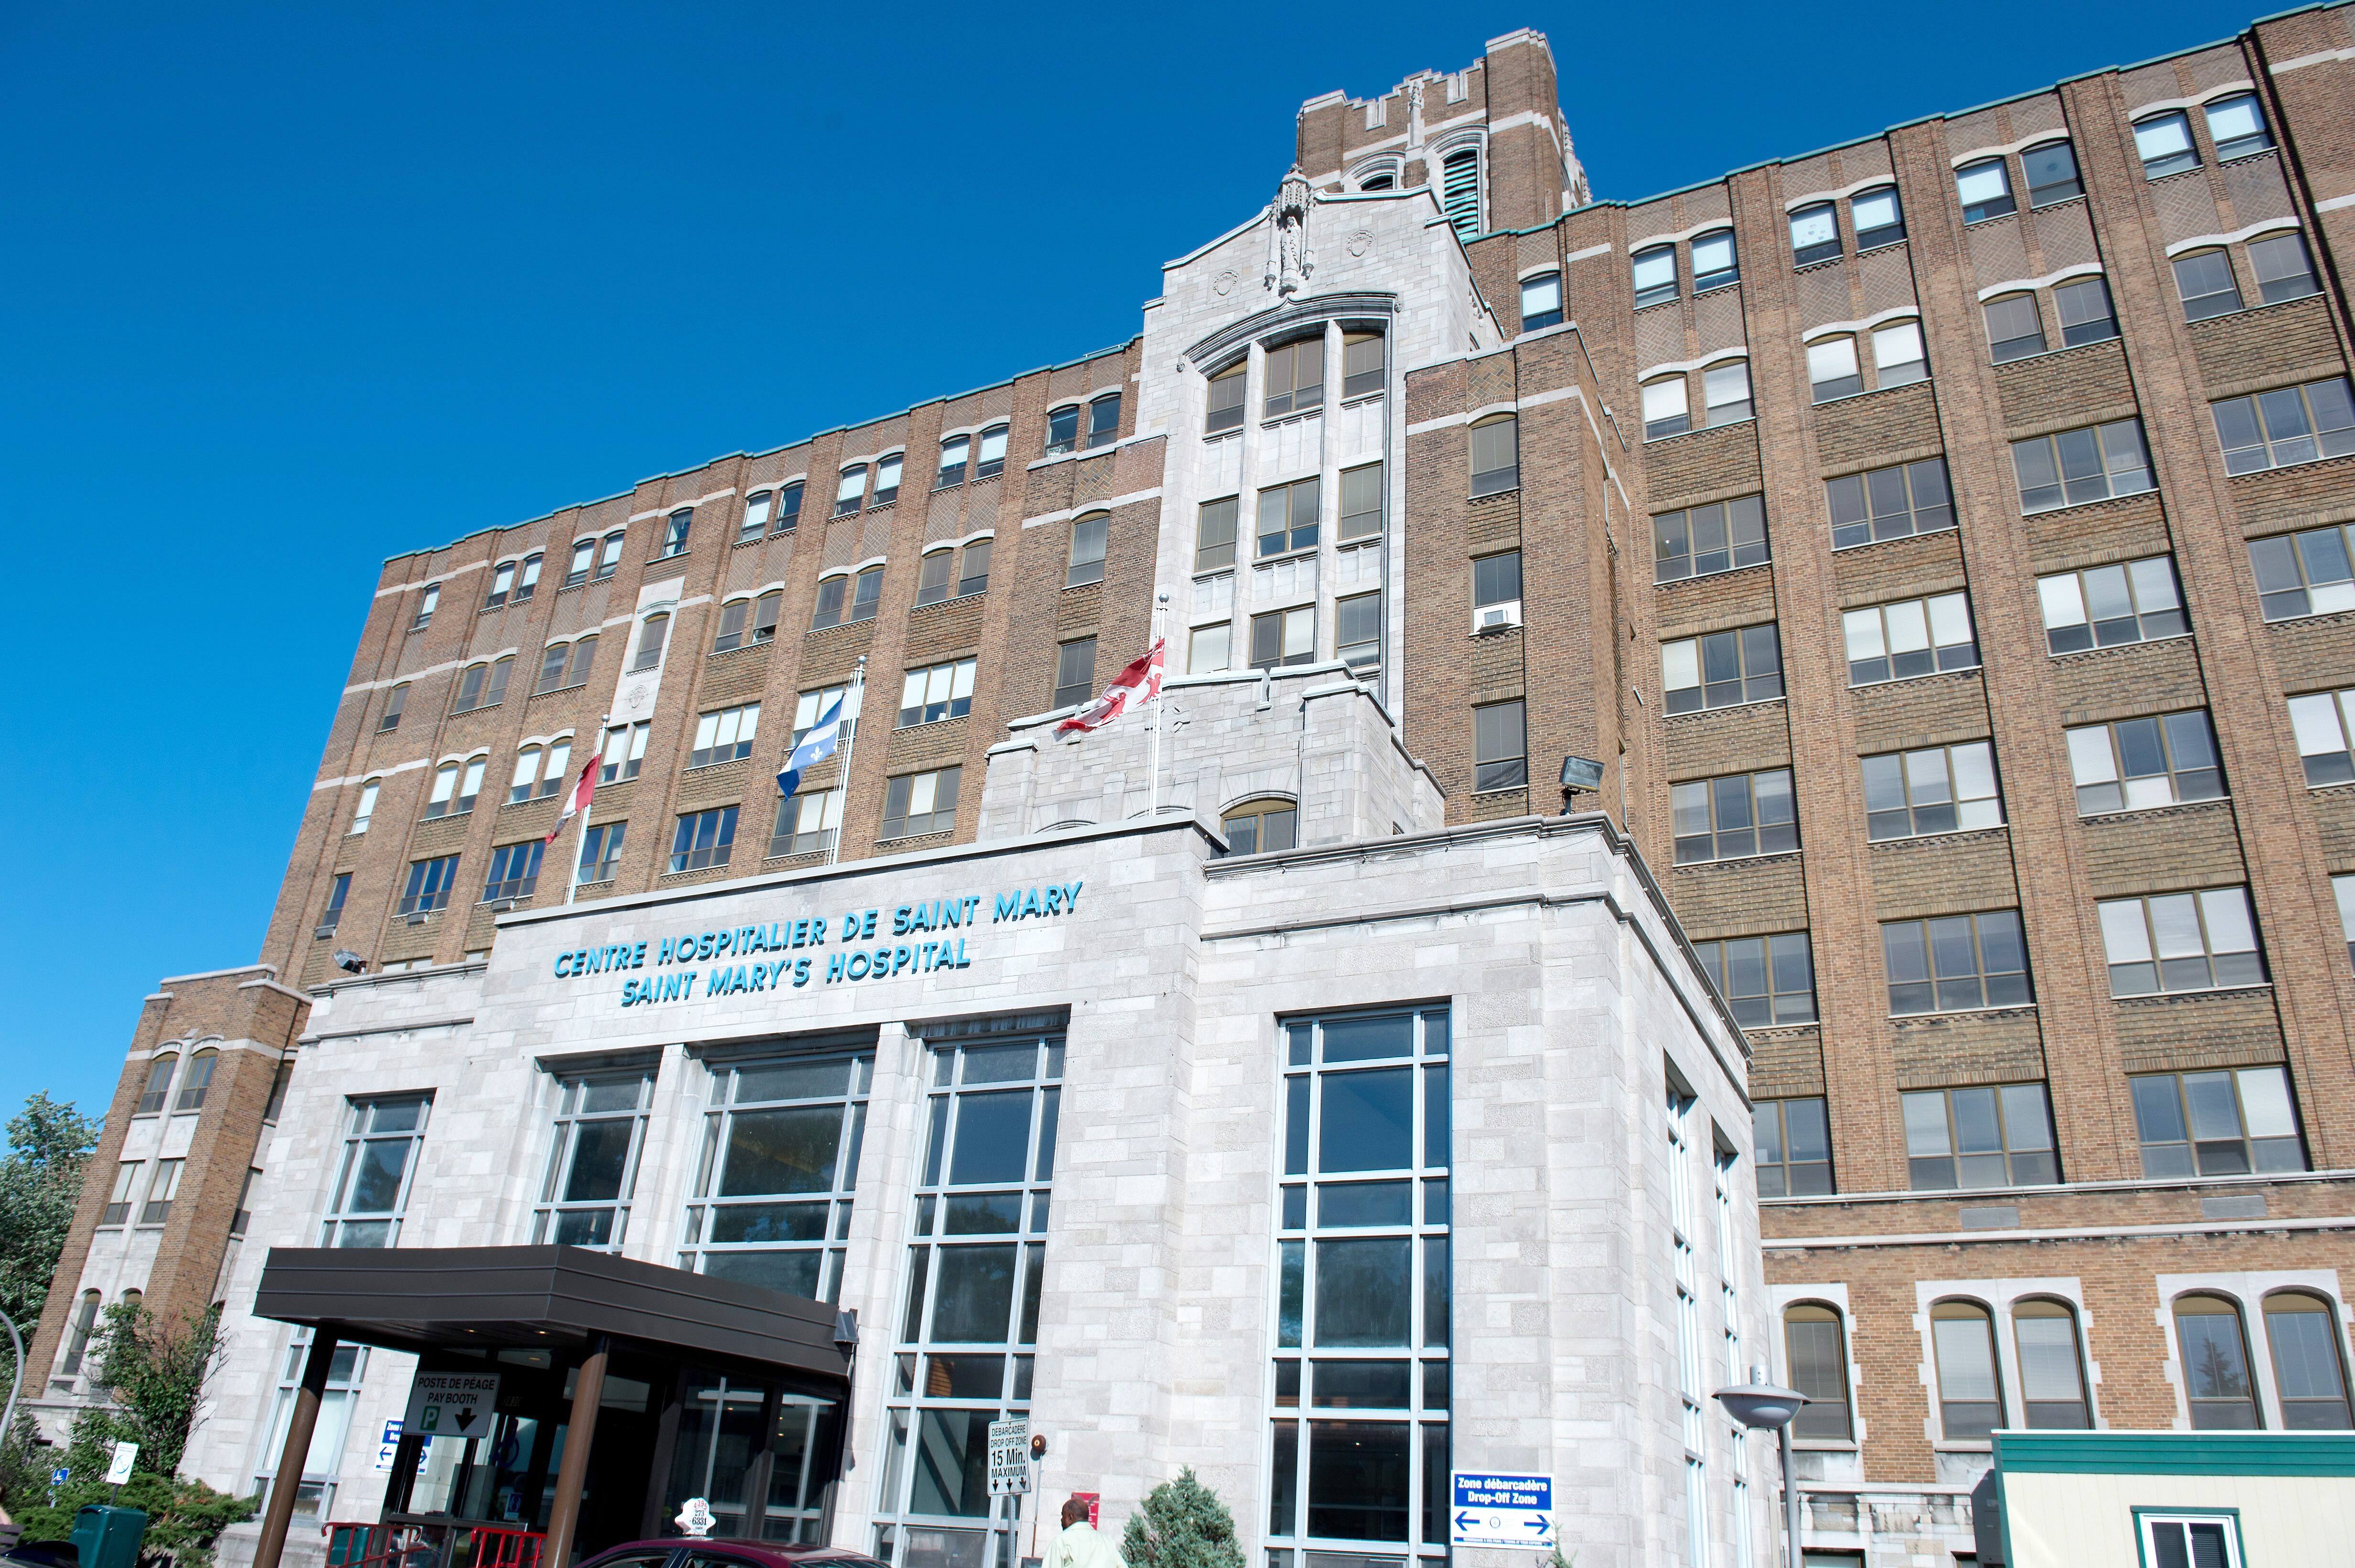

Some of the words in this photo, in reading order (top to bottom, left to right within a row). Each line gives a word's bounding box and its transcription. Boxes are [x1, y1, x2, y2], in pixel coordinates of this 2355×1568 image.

[554, 941, 647, 978] CENTRE
[658, 917, 827, 966] HOSPITALIER
[842, 909, 878, 942] DE
[892, 895, 980, 936] SAINT
[993, 881, 1083, 924] MARY
[621, 971, 697, 1007] SAINT
[707, 957, 811, 997] MARY'S
[826, 938, 971, 984] HOSPITAL
[418, 1377, 447, 1388] POSTE
[449, 1378, 462, 1389] DE
[463, 1377, 495, 1390] PÉAGE
[427, 1393, 445, 1403] PAY
[445, 1393, 478, 1404] BOOTH
[991, 1438, 1004, 1448] DROP
[1005, 1438, 1015, 1446] OFF
[1015, 1436, 1026, 1446] ZONE
[992, 1450, 1003, 1466] 15
[1006, 1448, 1025, 1465] Min.
[992, 1465, 1026, 1478] MAXIMUM
[1458, 1477, 1482, 1489] Zone
[1484, 1478, 1547, 1491] débarcadère
[1468, 1491, 1510, 1505] Drop-Off
[1512, 1493, 1537, 1504] Zone
